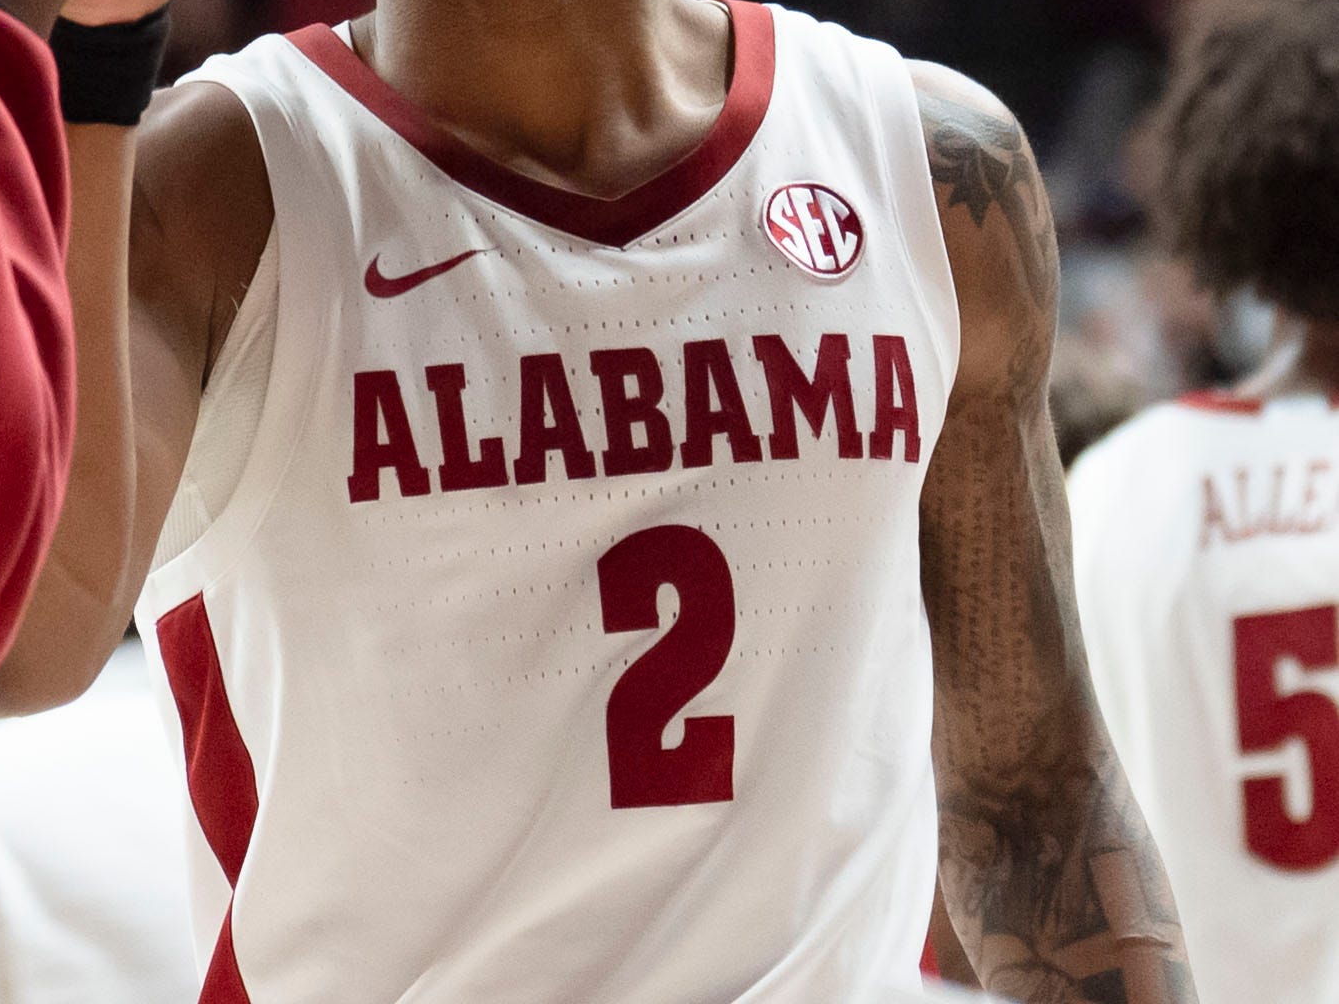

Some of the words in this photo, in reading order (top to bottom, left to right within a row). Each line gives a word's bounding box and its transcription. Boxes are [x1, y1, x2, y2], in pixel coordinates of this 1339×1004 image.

[769, 186, 859, 271] SEC
[347, 333, 921, 503] ALABAMA
[1199, 458, 1339, 550] ALLE
[597, 524, 736, 809] 2
[1232, 602, 1339, 873] 5
